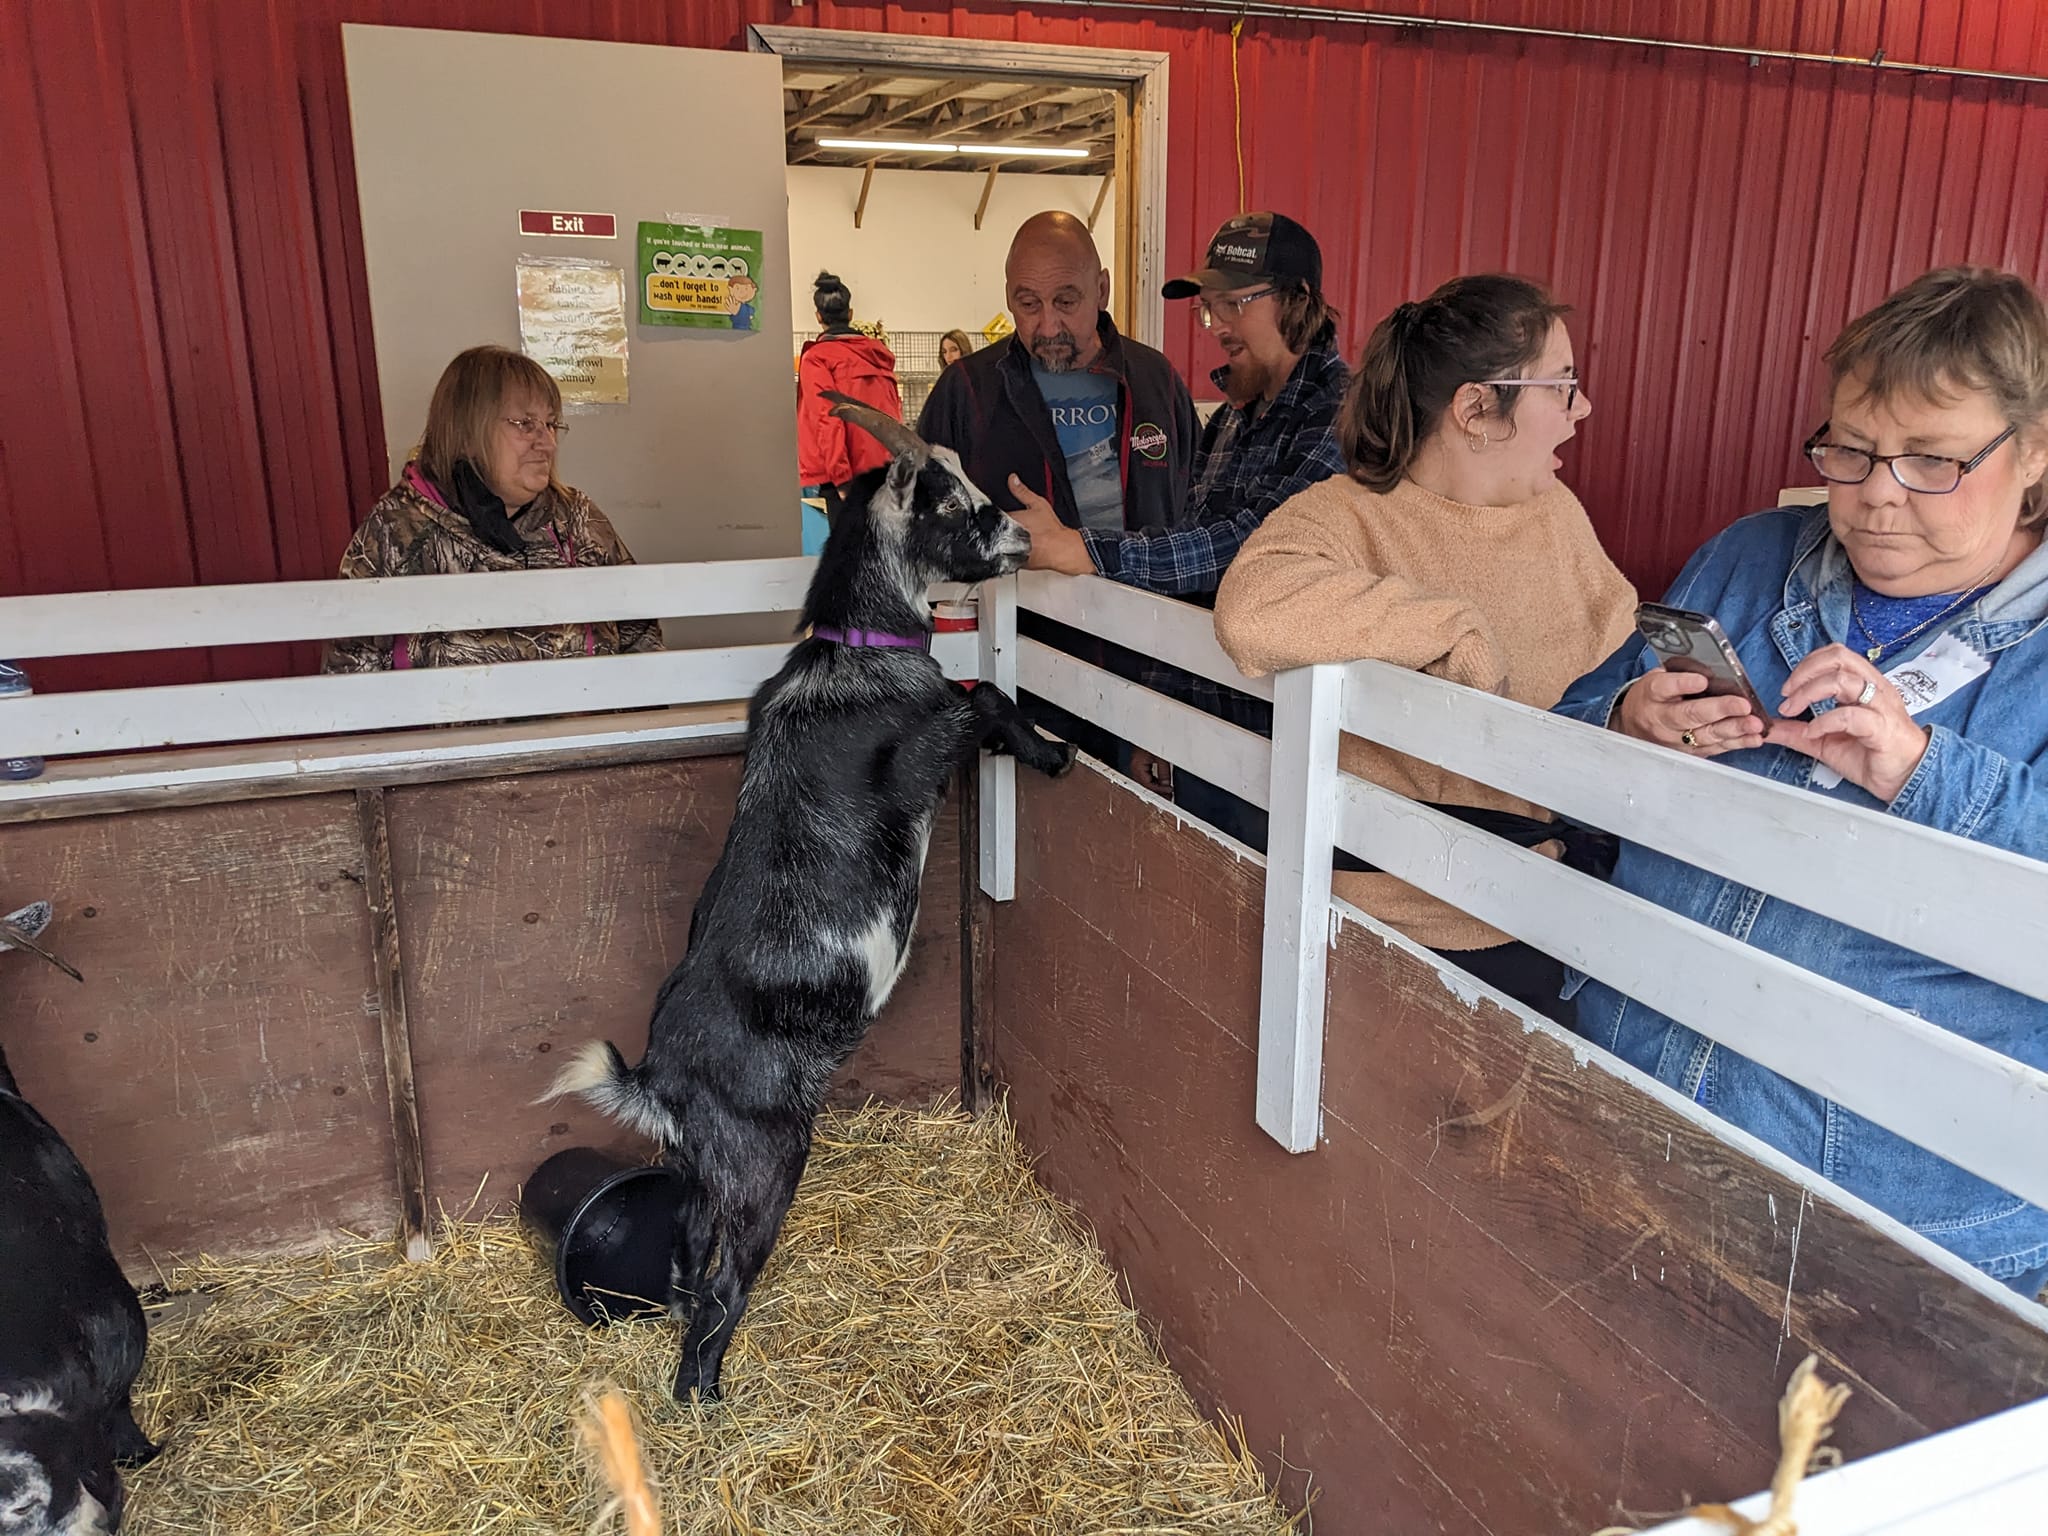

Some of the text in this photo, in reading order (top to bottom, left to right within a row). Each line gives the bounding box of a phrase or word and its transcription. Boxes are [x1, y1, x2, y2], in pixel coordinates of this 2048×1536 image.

[552, 215, 584, 233] Exit
[1226, 245, 1256, 259] Bobcat
[683, 280, 707, 292] forget
[710, 282, 719, 292] to
[653, 292, 723, 304] wash your hands!
